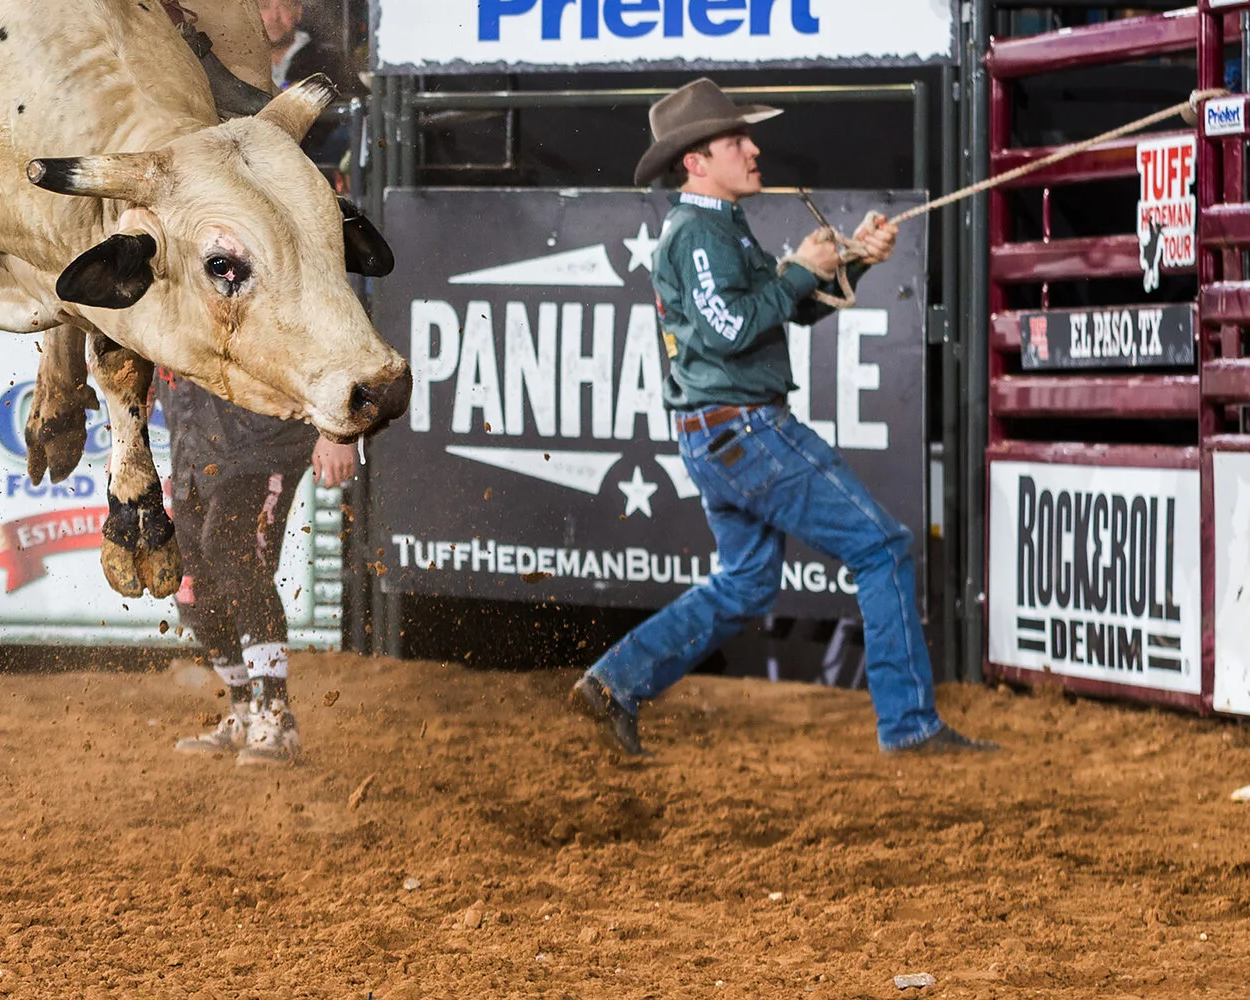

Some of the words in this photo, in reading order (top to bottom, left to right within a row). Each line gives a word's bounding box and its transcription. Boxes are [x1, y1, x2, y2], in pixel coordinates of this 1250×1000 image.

[1141, 145, 1193, 202] TUFF
[1141, 203, 1192, 233] HEDEMAN
[1165, 234, 1192, 261] TOUR
[1069, 313, 1091, 358] EL
[1092, 310, 1137, 366] PASO,
[1138, 309, 1163, 356] TX
[410, 299, 889, 450] PANHALE
[1050, 617, 1144, 673] DENIM
